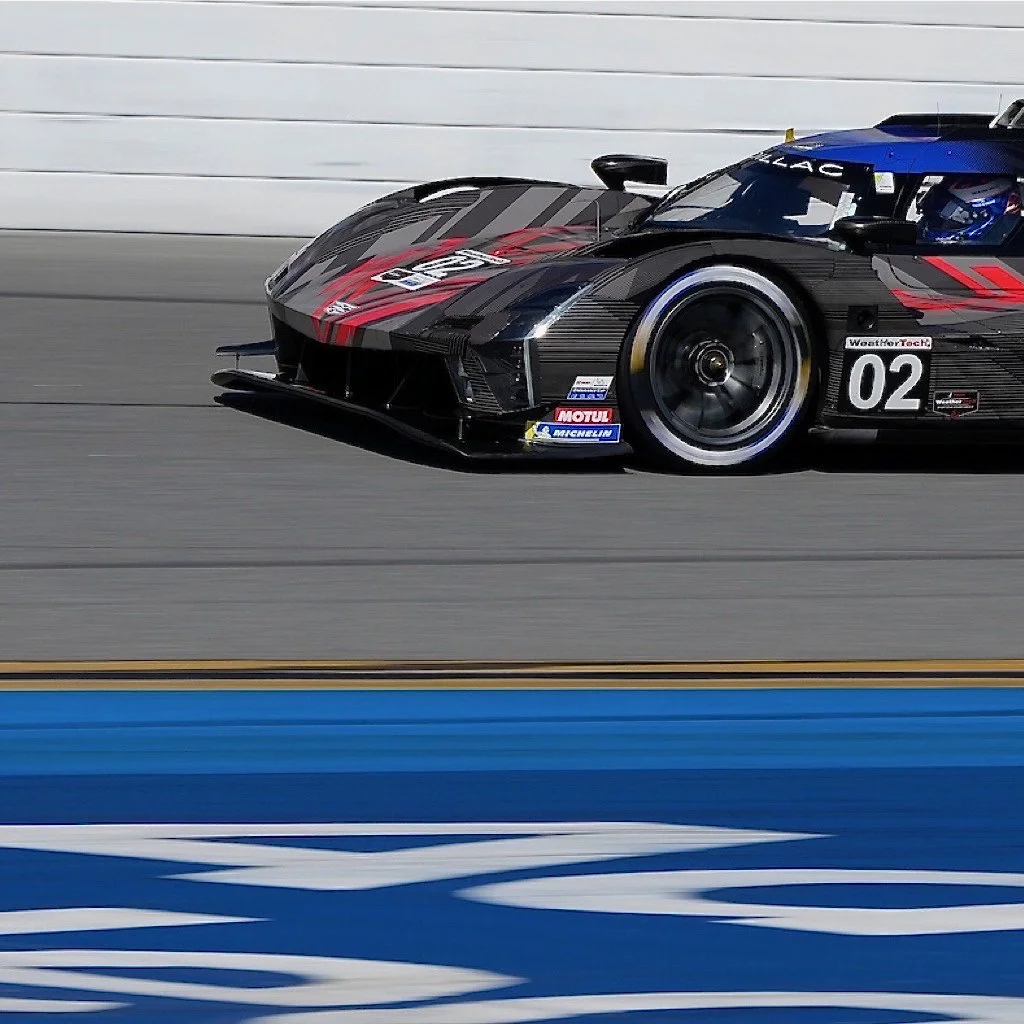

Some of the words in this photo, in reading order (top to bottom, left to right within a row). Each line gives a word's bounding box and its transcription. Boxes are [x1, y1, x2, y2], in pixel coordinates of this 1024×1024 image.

[849, 339, 931, 348] WeatherTech
[849, 353, 923, 410] 02
[557, 410, 609, 423] MOTUL
[552, 429, 612, 438] MICHELIN
